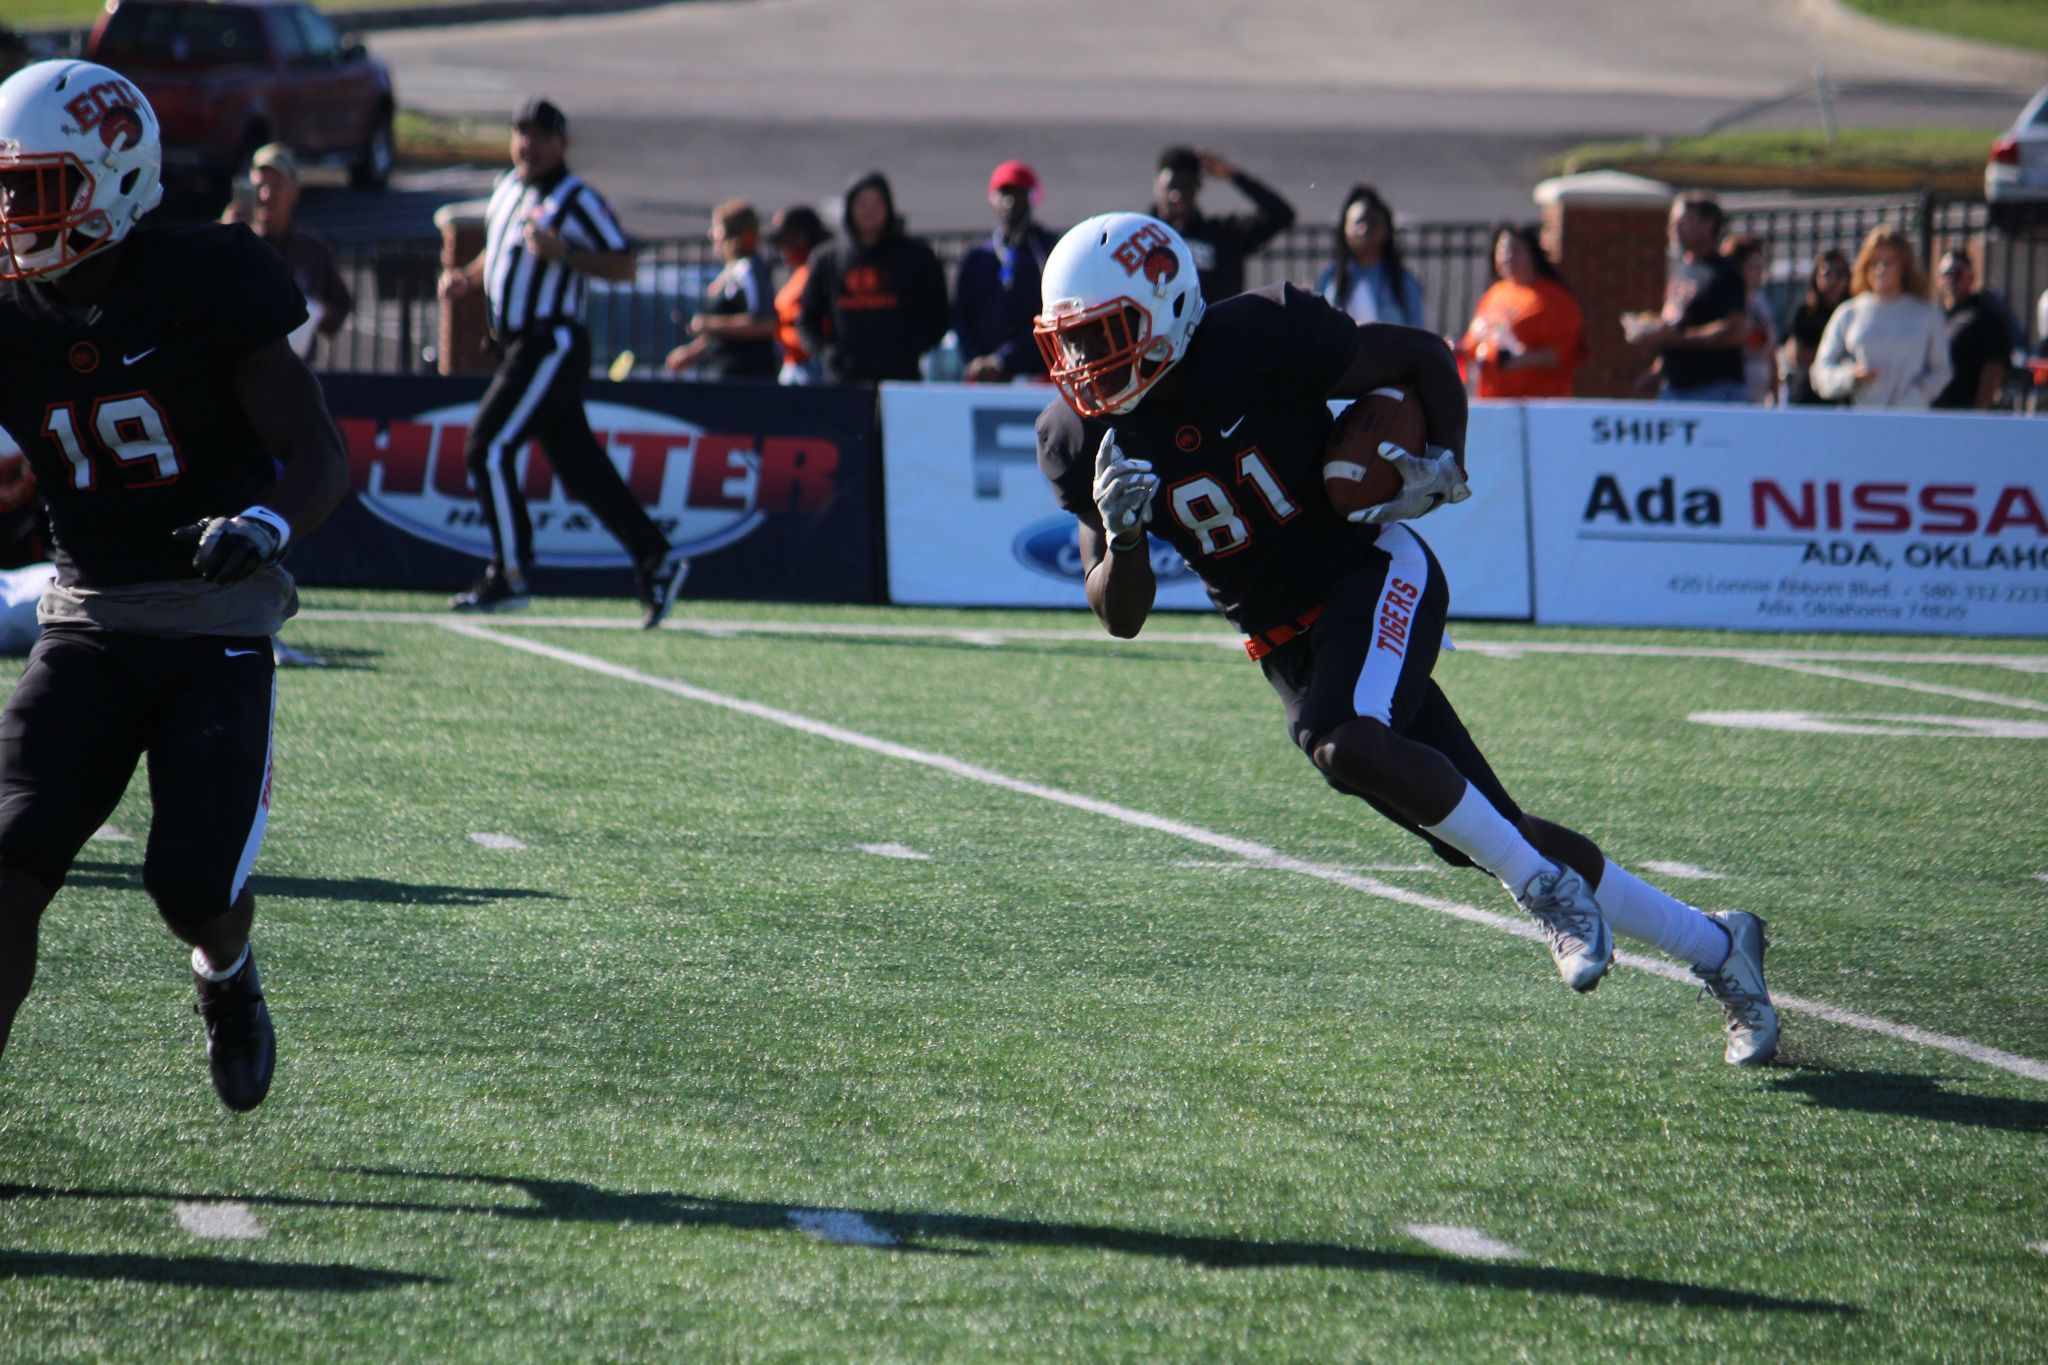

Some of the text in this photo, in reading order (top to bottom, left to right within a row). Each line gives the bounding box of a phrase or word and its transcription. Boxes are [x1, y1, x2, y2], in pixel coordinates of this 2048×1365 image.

[64, 80, 141, 136] ECU
[1110, 223, 1172, 278] ECU
[41, 389, 185, 491] 19
[563, 512, 592, 533] &
[1167, 446, 1302, 559] 81
[1583, 473, 2048, 537] Ada NISSA
[1801, 540, 1892, 572] ADA,
[1705, 575, 1771, 595] Lonnie
[1802, 601, 1903, 621] Oklahoma
[1376, 578, 1419, 659] TIGERS
